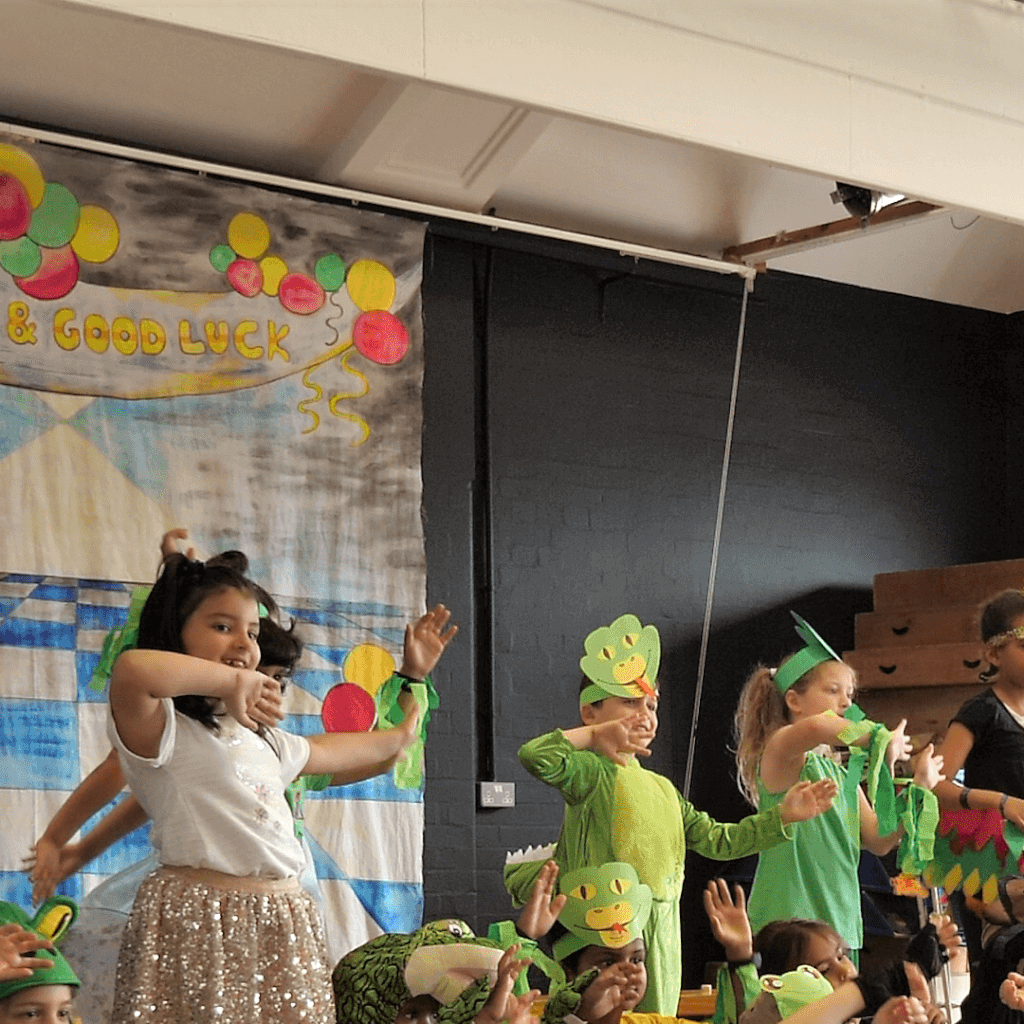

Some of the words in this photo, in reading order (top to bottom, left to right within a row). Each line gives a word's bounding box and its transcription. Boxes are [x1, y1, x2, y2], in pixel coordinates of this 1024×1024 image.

[7, 300, 38, 345] &
[53, 306, 167, 356] GOOD
[178, 318, 291, 363] LUCK
